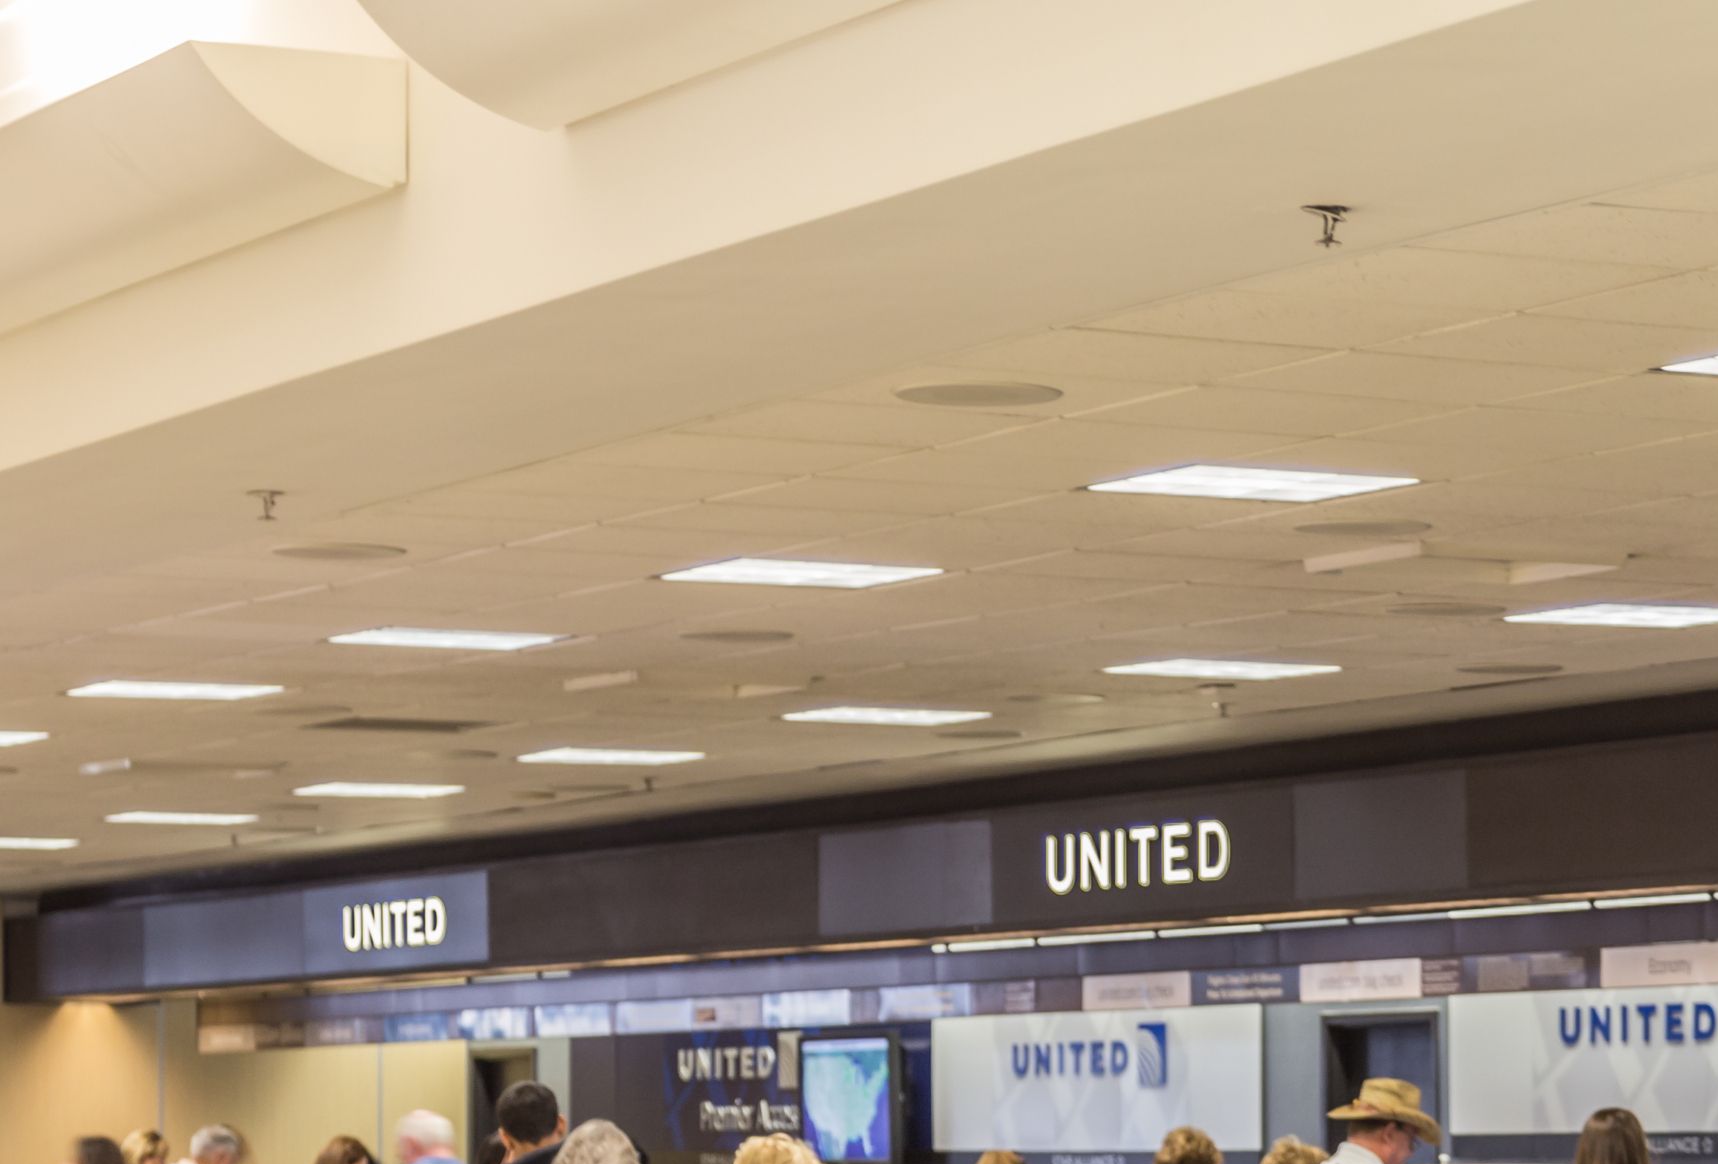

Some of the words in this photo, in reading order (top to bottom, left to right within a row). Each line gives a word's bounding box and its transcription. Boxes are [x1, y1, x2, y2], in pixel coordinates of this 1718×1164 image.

[1045, 818, 1231, 895] UNITED
[341, 896, 447, 952] UNITED
[1559, 1001, 1717, 1047] UNITED
[677, 1045, 776, 1082] UNITED
[1011, 1038, 1130, 1079] UNITED
